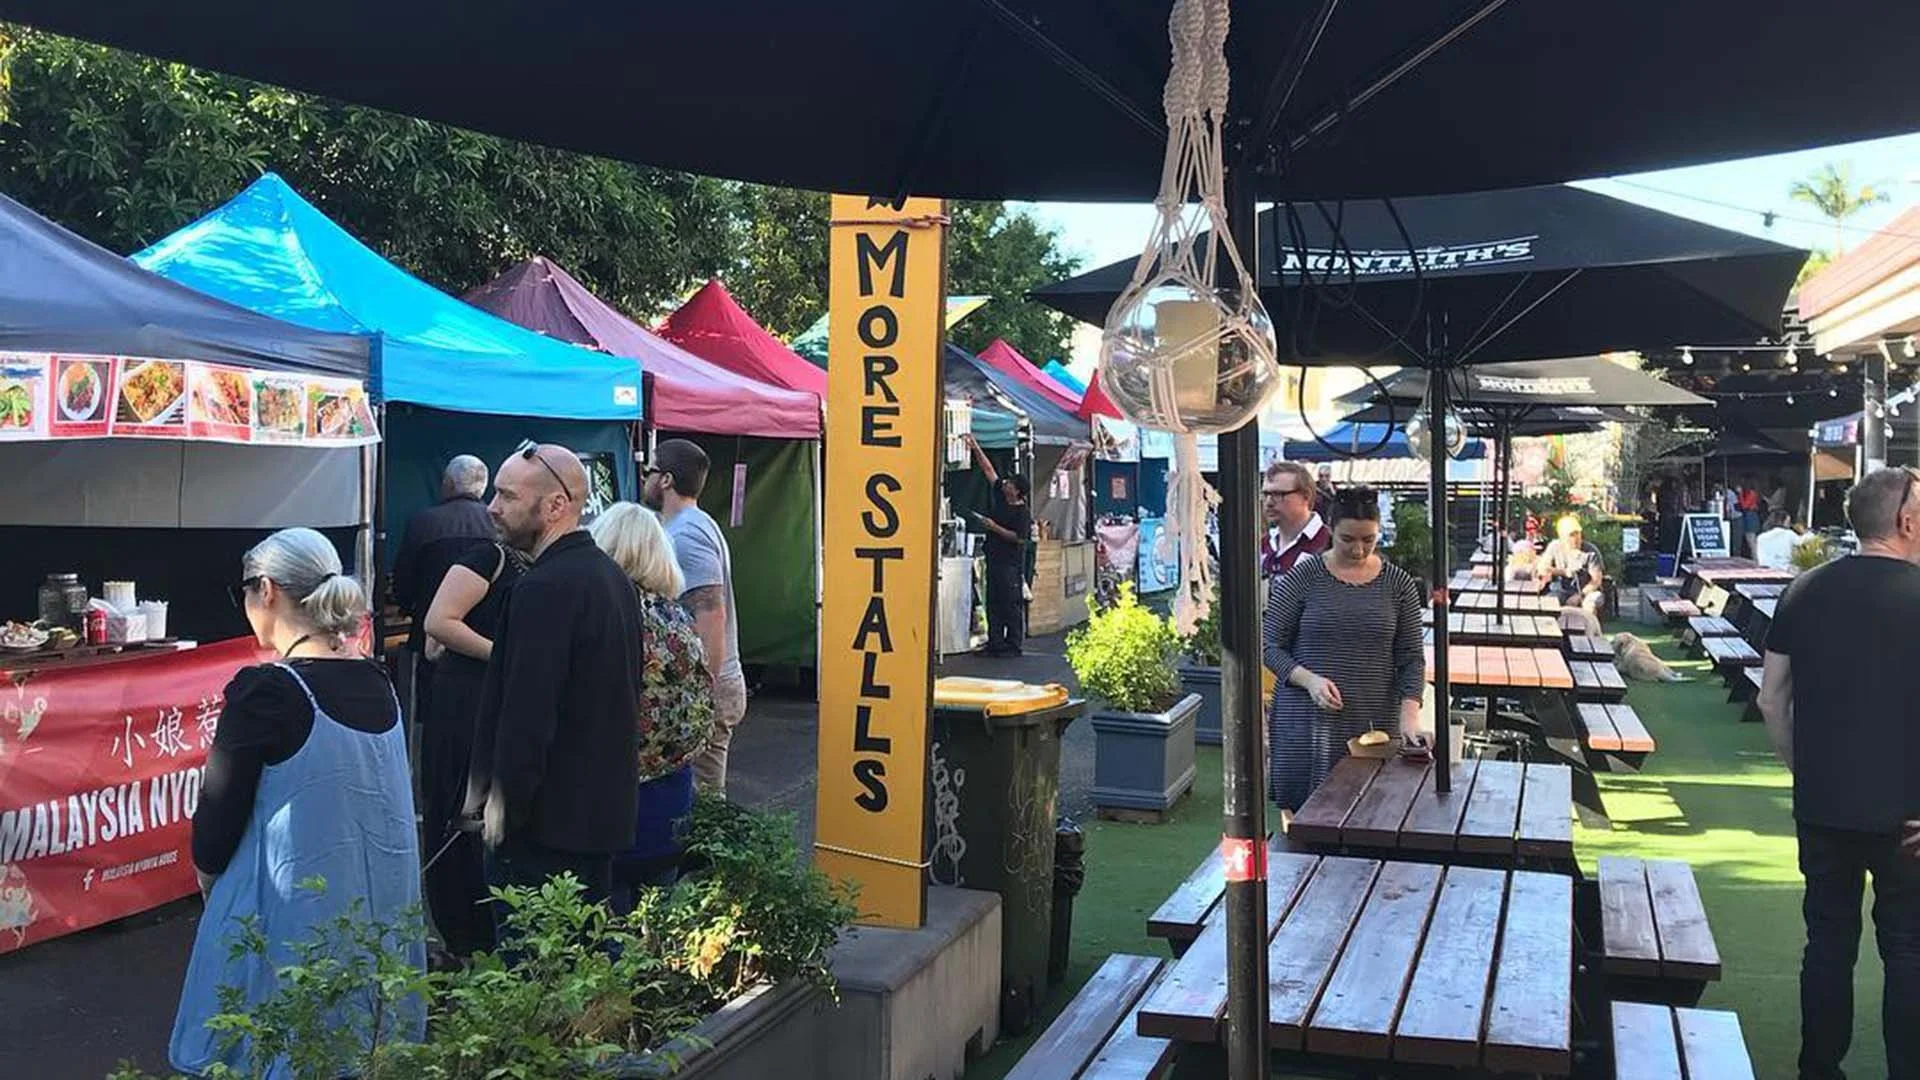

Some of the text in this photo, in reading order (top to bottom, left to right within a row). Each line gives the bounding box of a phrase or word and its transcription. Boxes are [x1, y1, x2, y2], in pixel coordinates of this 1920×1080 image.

[1282, 241, 1531, 271] MONTEITH'S
[851, 230, 909, 814] MORE STALLS
[0, 765, 206, 864] MALAYSIA NYO
